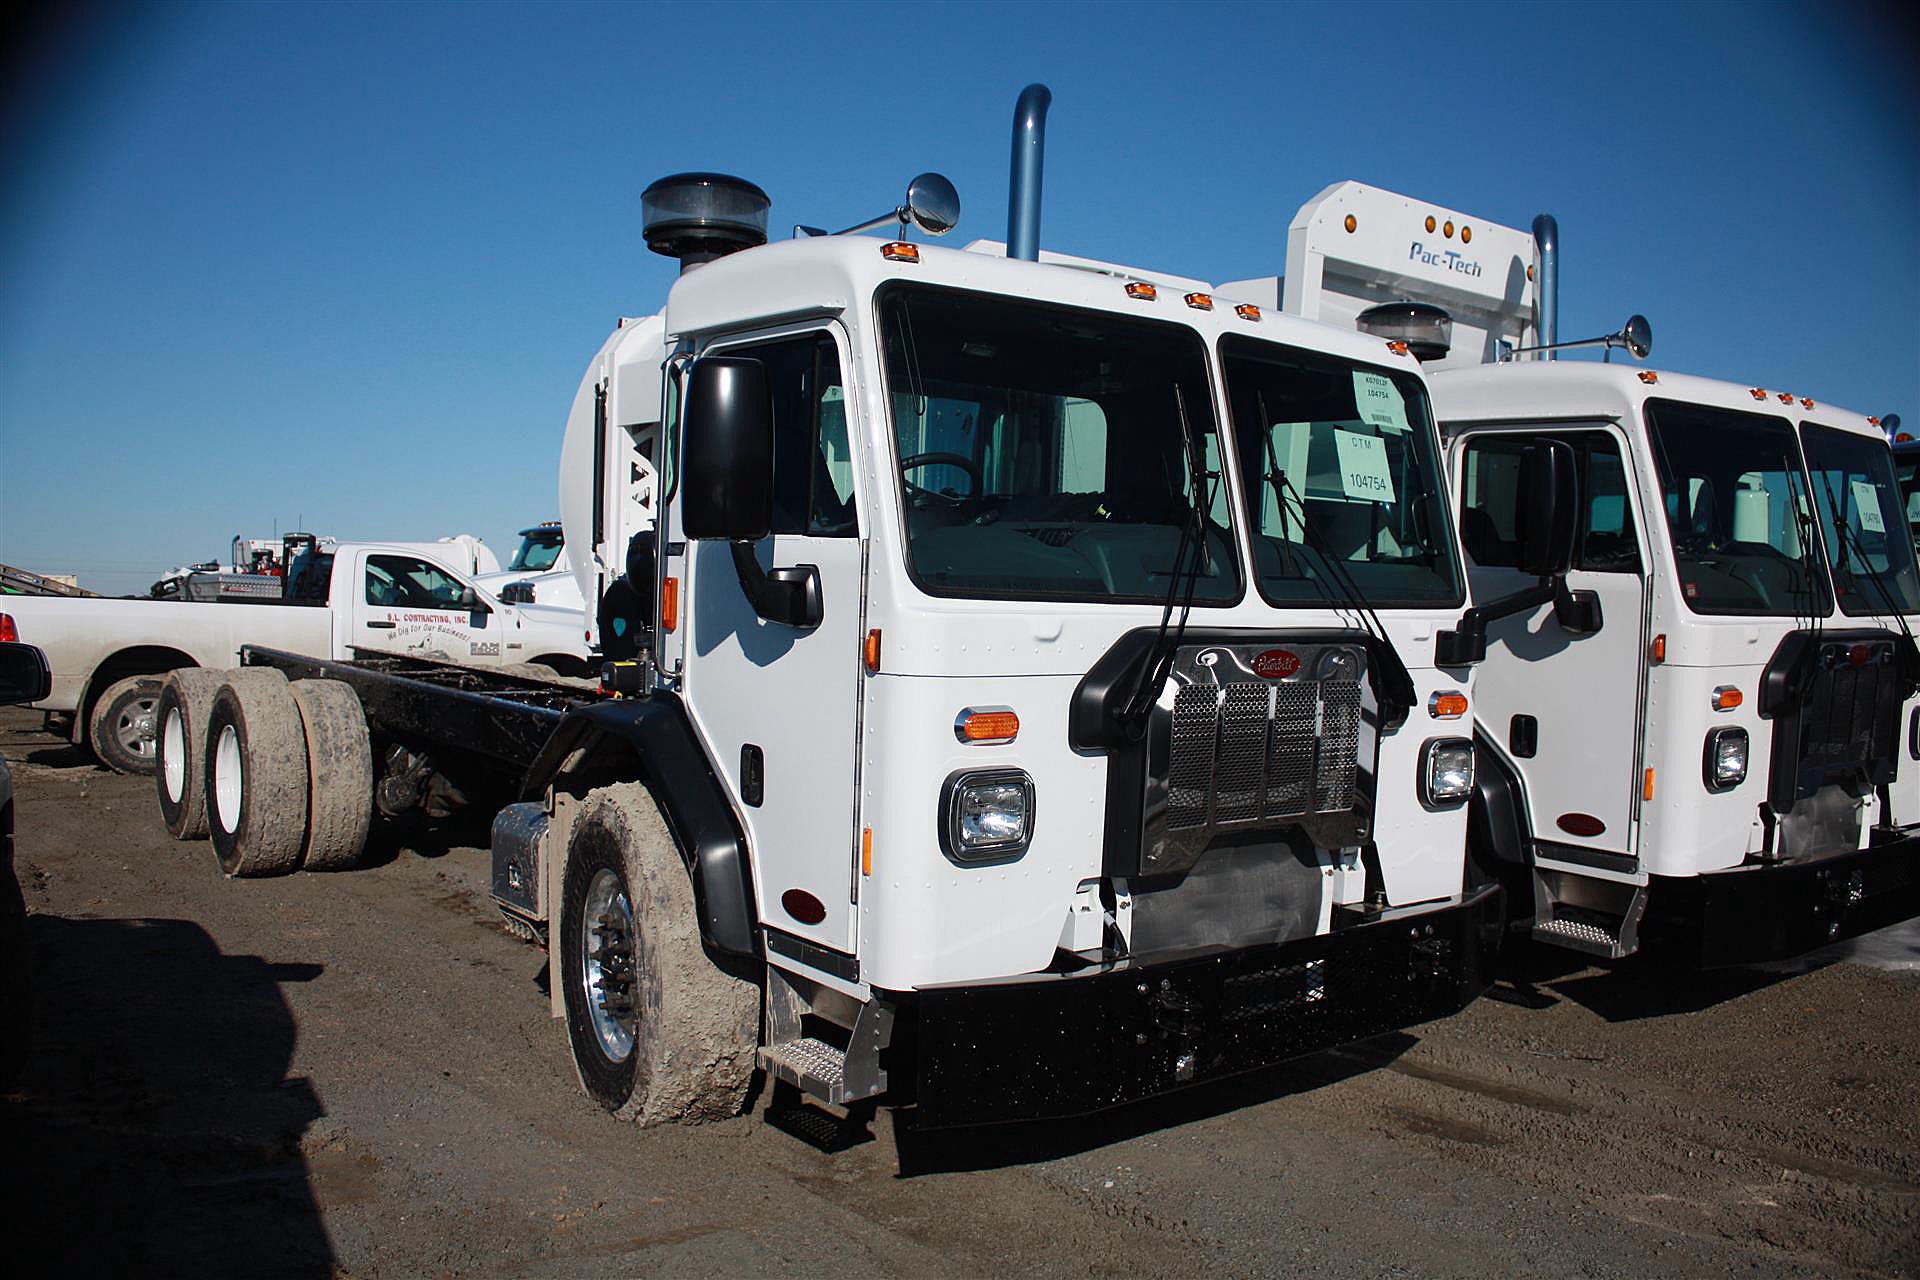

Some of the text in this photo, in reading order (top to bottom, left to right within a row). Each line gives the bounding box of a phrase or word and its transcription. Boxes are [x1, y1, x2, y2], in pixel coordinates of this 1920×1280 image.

[1409, 241, 1481, 277] Pac-Tech
[1352, 437, 1372, 449] CTM
[1350, 473, 1387, 491] 104754
